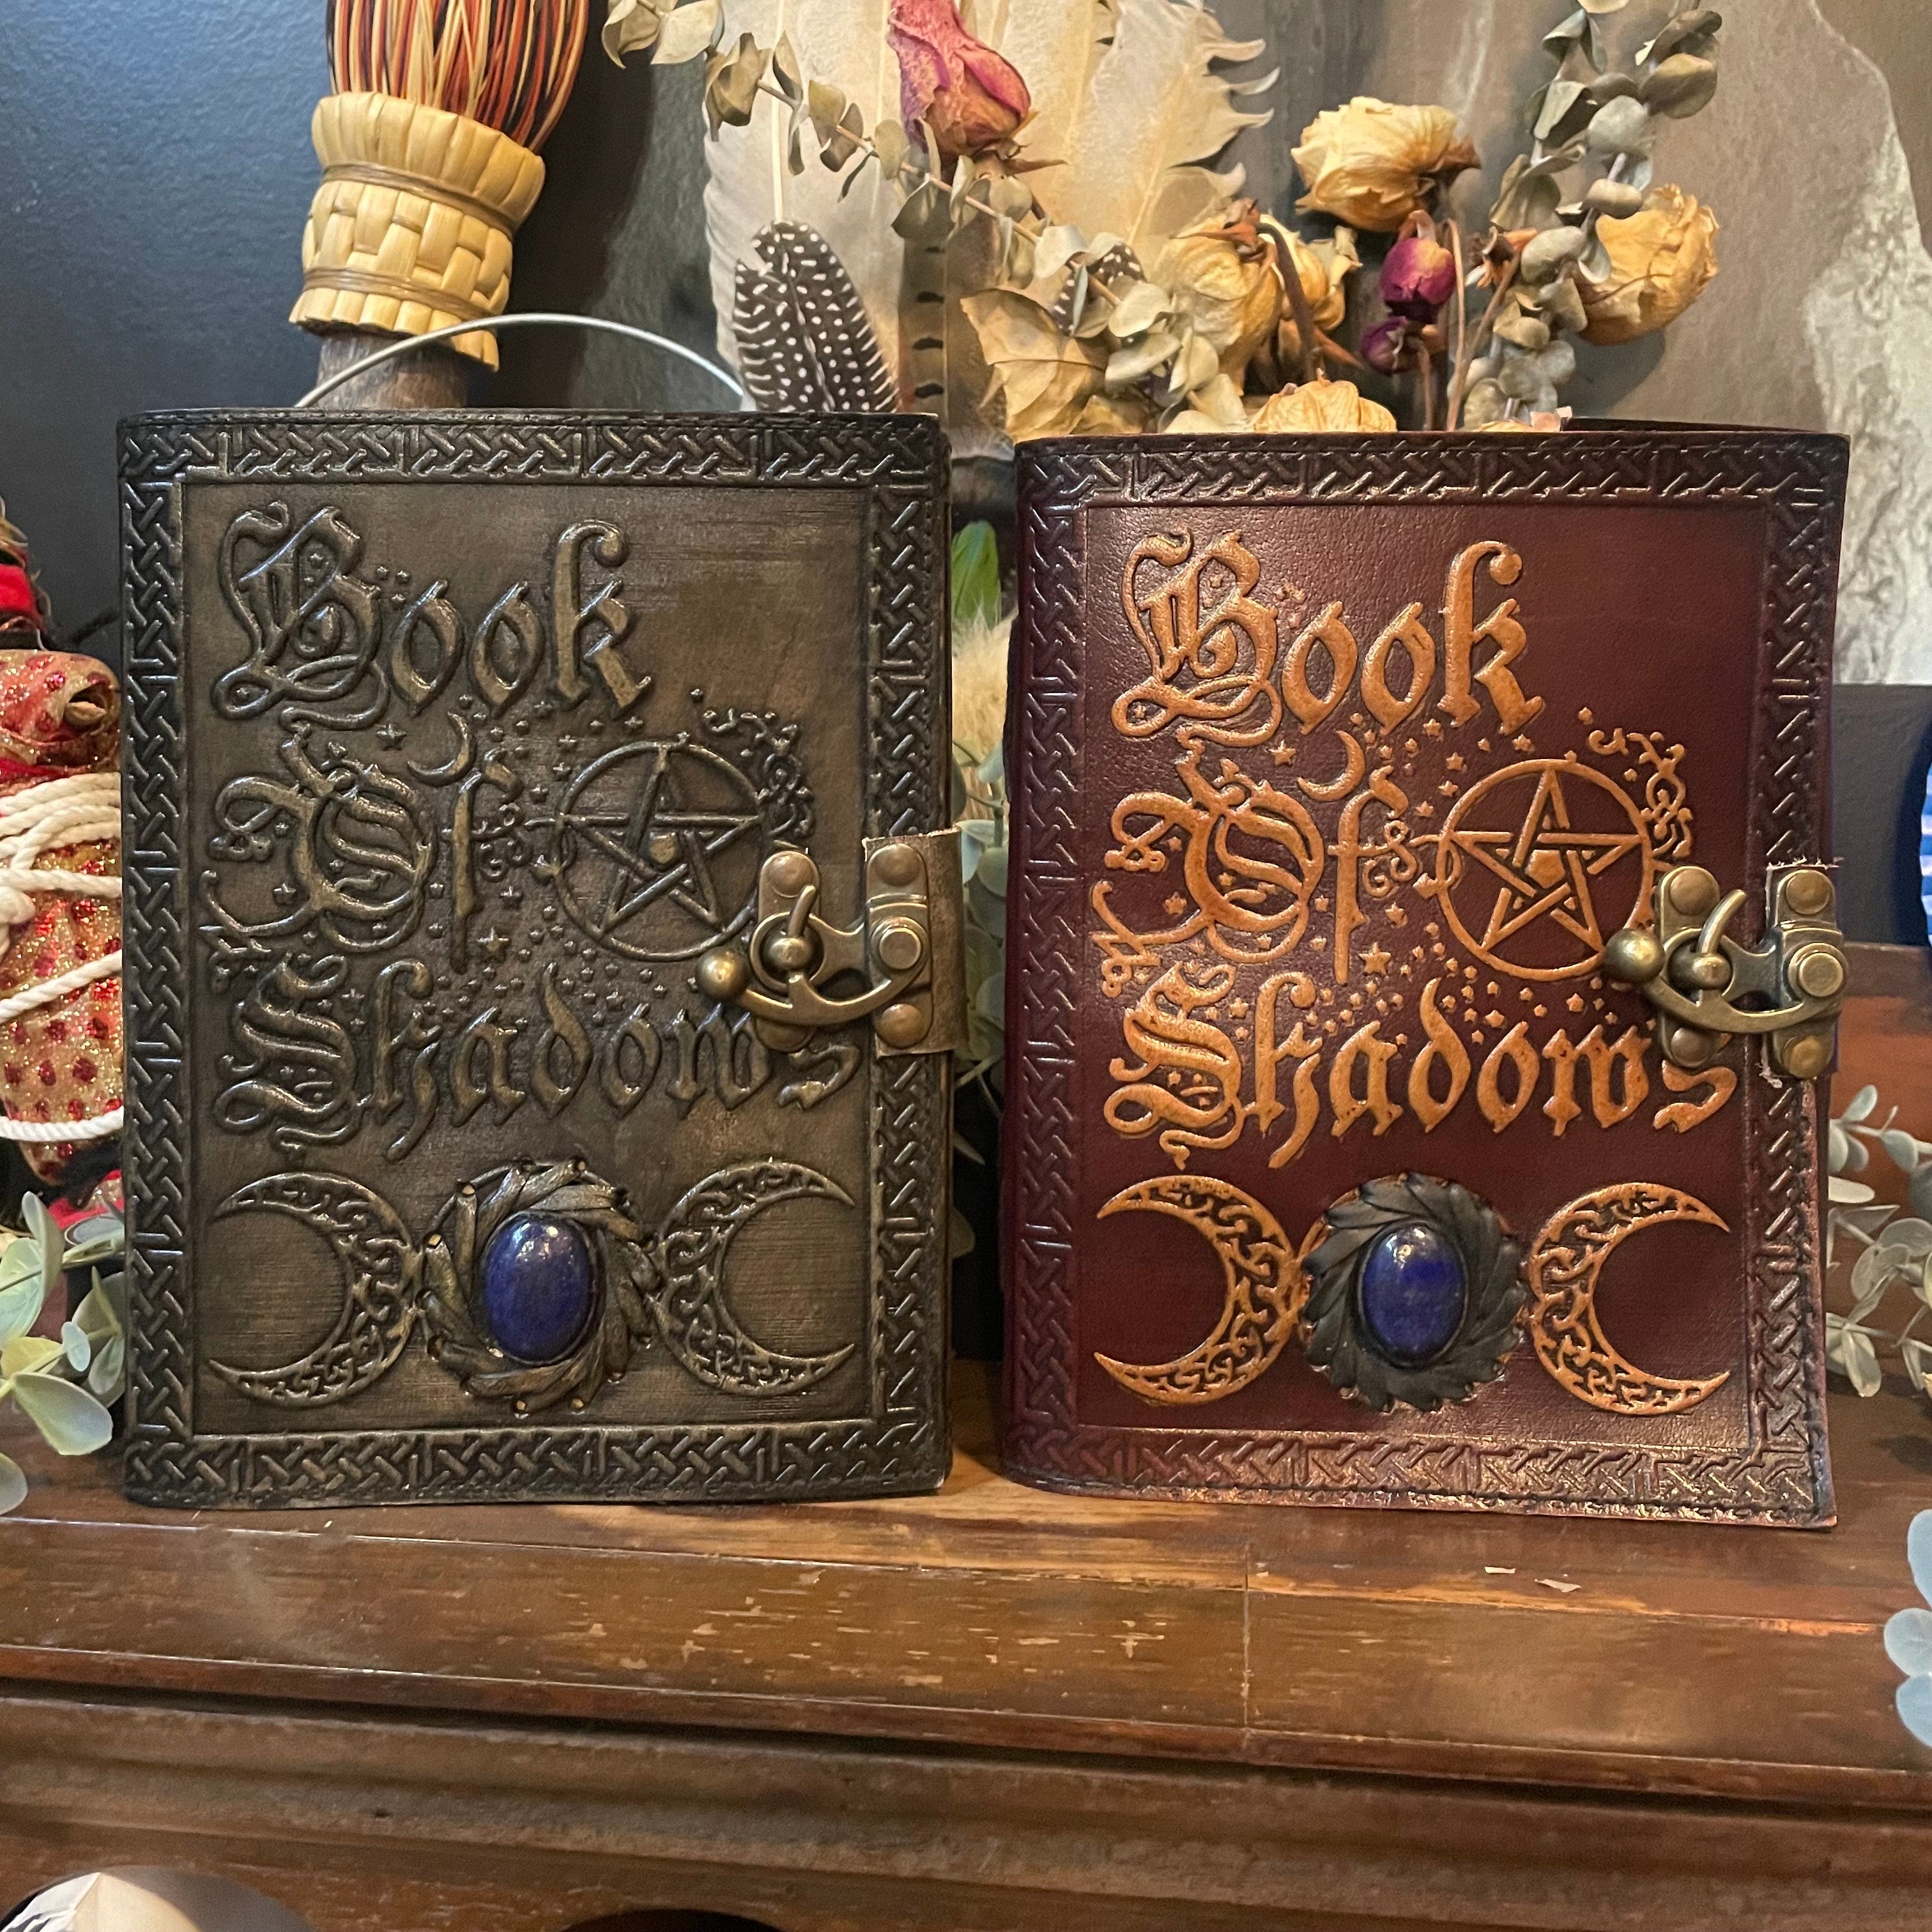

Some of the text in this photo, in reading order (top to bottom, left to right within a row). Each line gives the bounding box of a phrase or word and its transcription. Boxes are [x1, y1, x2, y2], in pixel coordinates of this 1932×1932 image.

[211, 501, 652, 732] Book
[1110, 528, 1545, 747] Book
[199, 722, 523, 993] Of
[1090, 736, 1416, 998] Of
[213, 951, 861, 1162] Shadows
[1103, 960, 1738, 1170] Shadows
